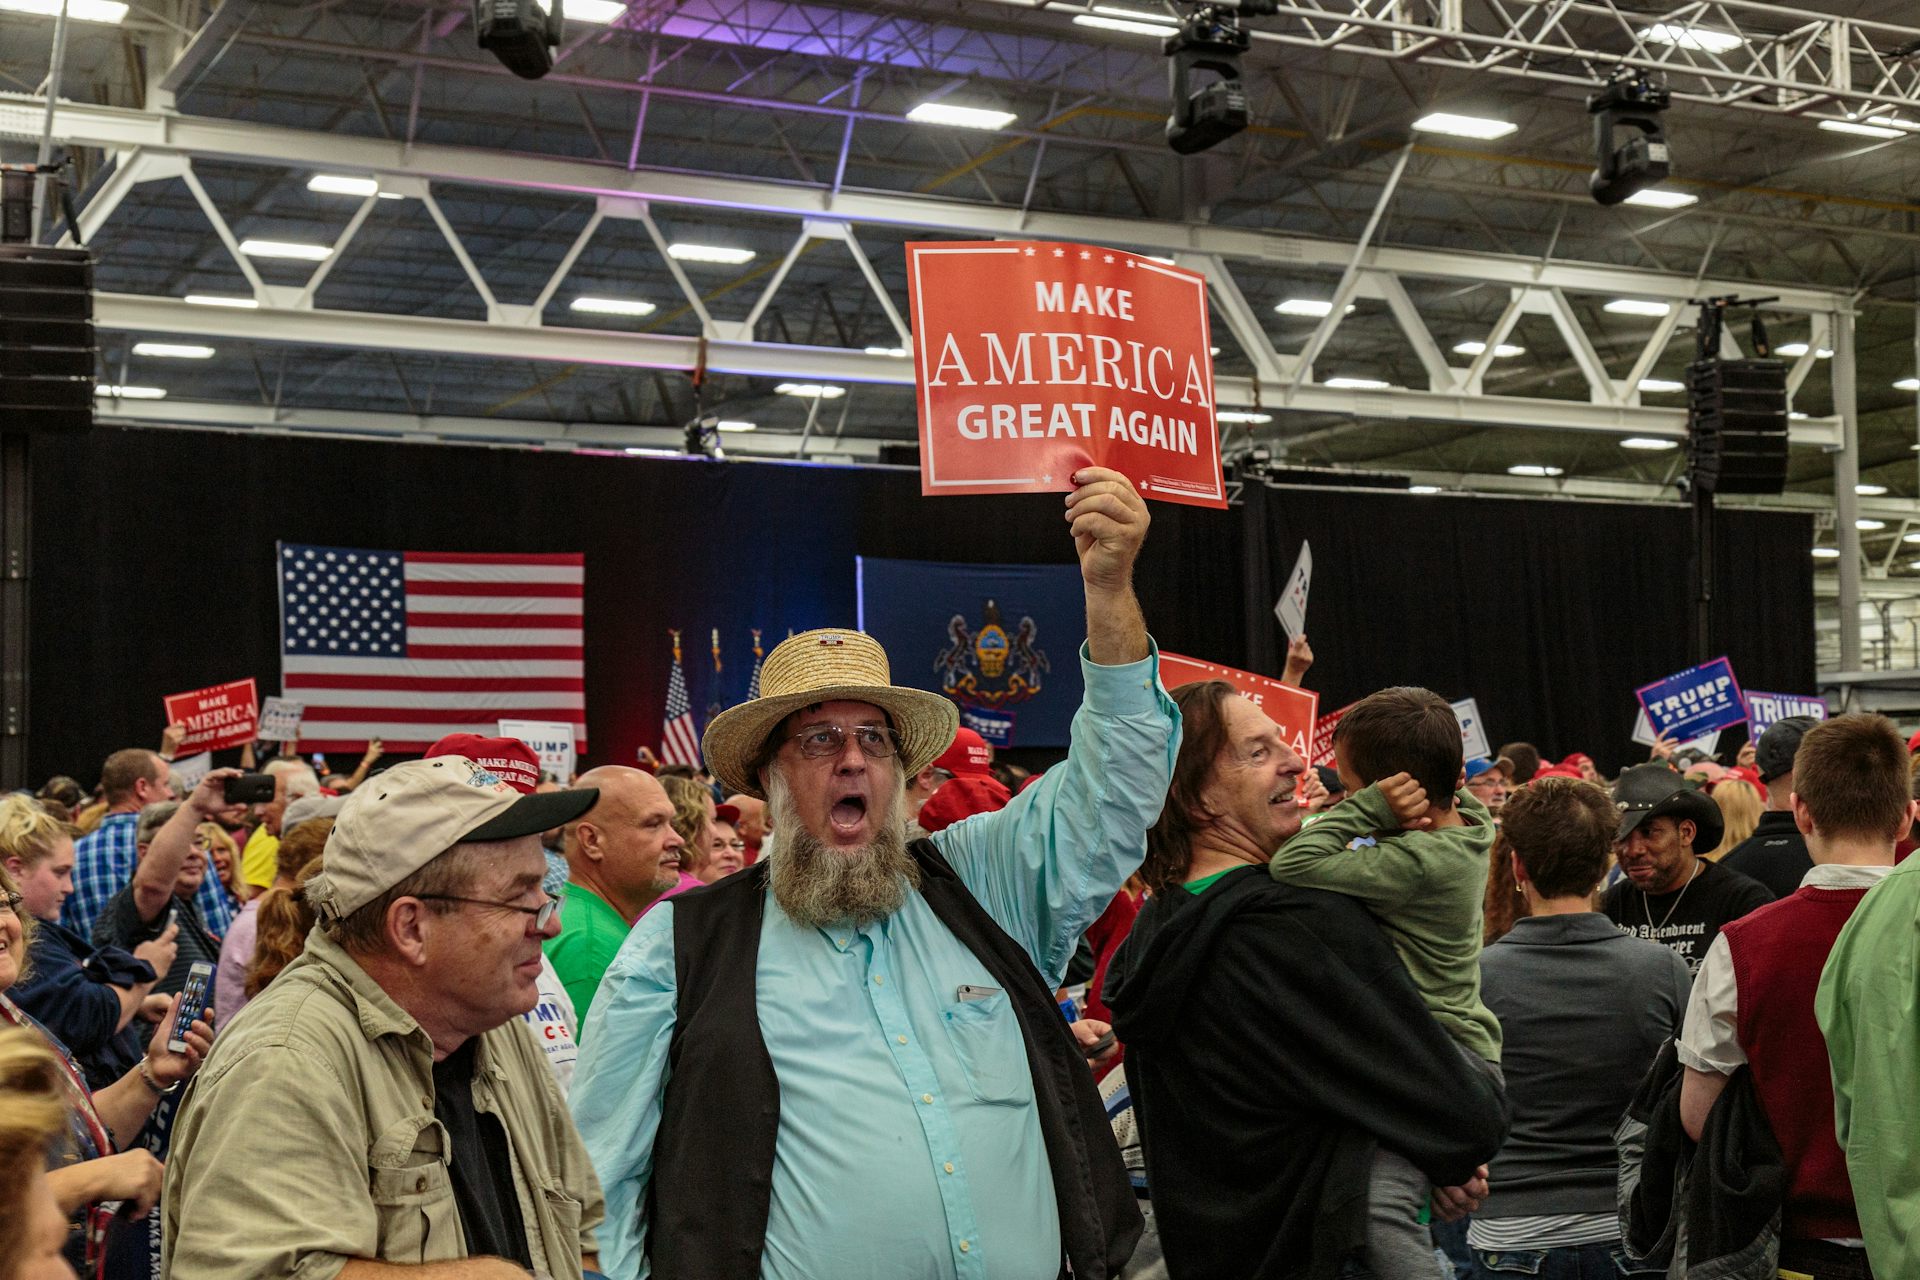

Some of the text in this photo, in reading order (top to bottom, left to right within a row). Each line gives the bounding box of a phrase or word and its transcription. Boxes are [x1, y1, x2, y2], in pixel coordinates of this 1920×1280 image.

[1035, 282, 1135, 321] MAKE
[929, 333, 1209, 409] AMERICA
[957, 403, 1198, 456] GREAT AGAIN
[199, 694, 228, 710] MAKE
[1648, 675, 1731, 716] TRUMP
[1662, 692, 1729, 724] PENCE
[1749, 696, 1825, 723] TRUMP
[180, 703, 256, 731] MERICA
[218, 721, 252, 737] AGAIN
[477, 757, 507, 768] MAKE
